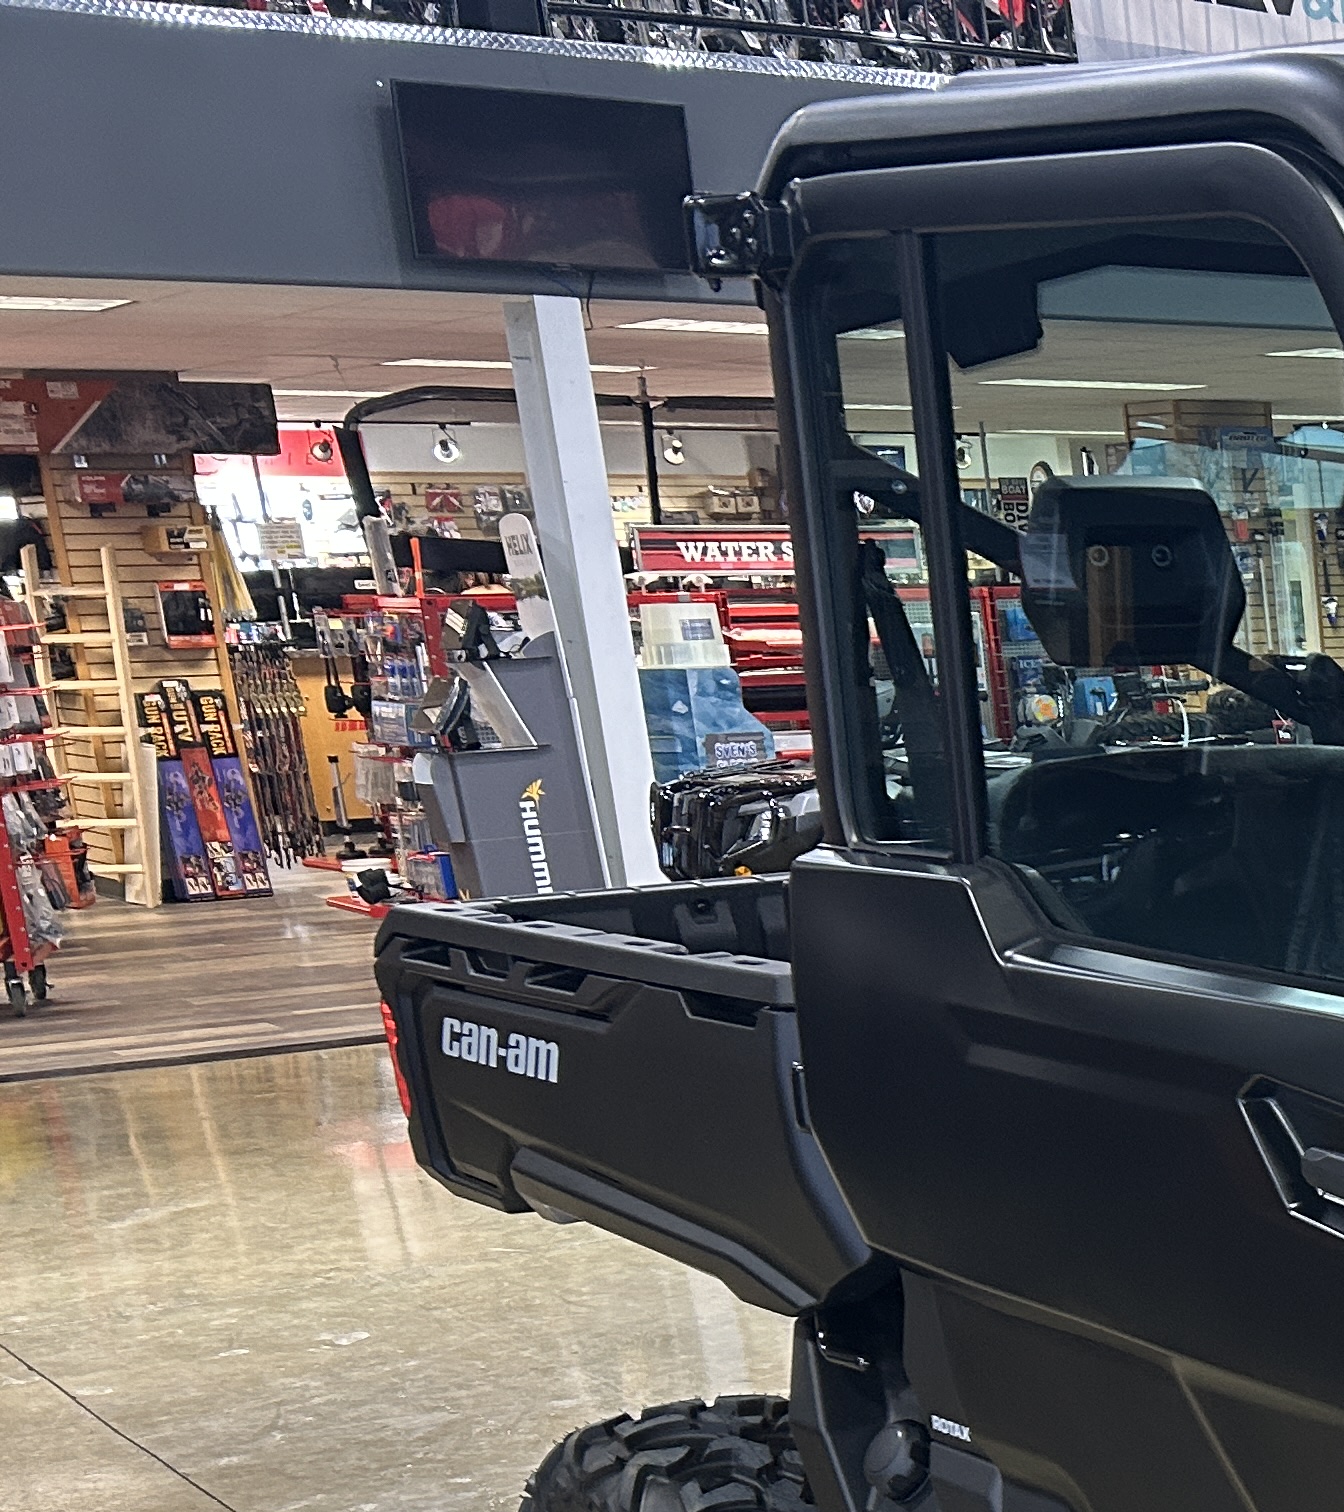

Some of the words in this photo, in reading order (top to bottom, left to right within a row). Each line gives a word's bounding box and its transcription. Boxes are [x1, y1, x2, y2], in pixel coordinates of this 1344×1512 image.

[503, 532, 533, 556] HELIX
[677, 541, 782, 563] WATER
[143, 699, 163, 724] GUN
[200, 696, 219, 722] GUN
[206, 724, 228, 756] RACK
[441, 1016, 560, 1084] can-am
[930, 1414, 972, 1442] ROTAX
